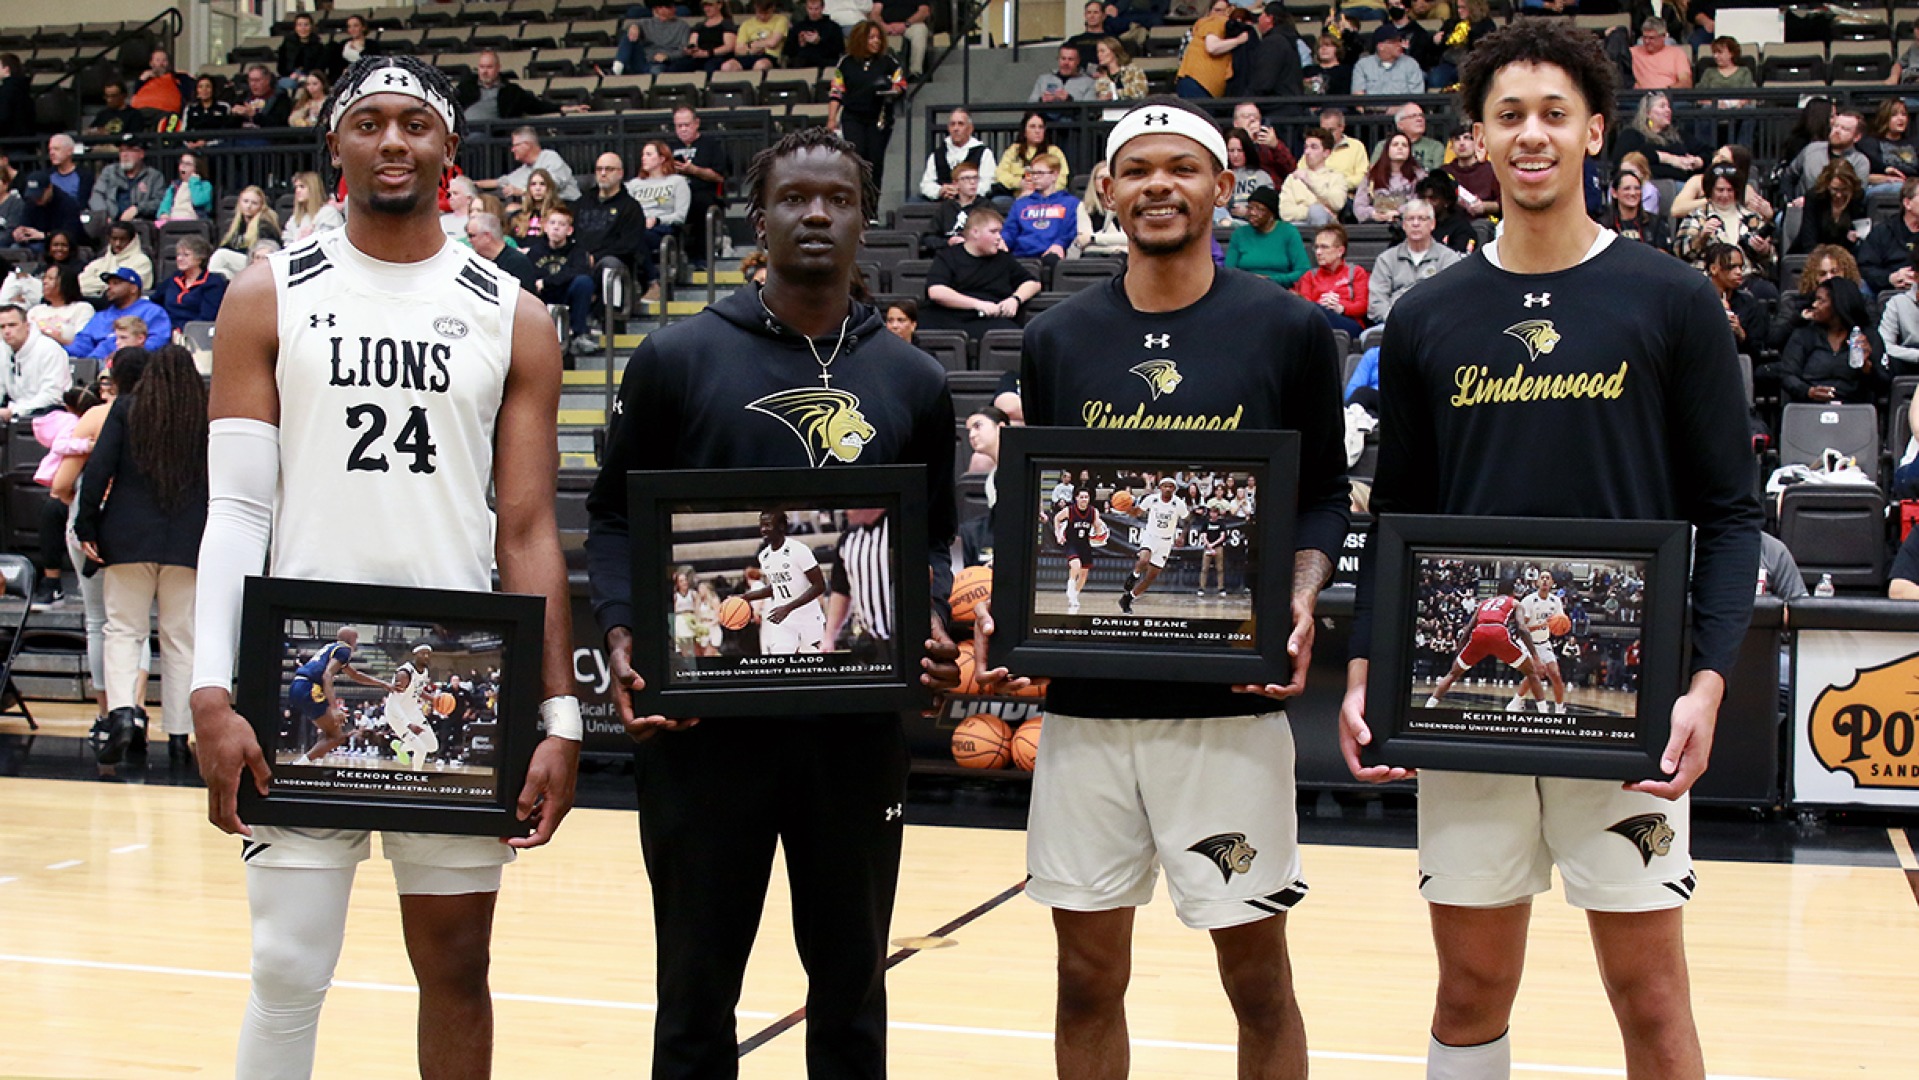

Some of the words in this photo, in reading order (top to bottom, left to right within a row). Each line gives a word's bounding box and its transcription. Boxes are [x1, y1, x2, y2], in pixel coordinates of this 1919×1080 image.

[329, 336, 451, 393] LIONS
[1451, 360, 1628, 407] Lindenwood
[1082, 400, 1244, 431] Lindenwood
[346, 403, 437, 474] 24
[1092, 617, 1140, 627] DARIUS
[1144, 619, 1188, 628] BEANE
[1033, 627, 1089, 636] LINDENWOOD
[1090, 629, 1140, 637] UNIVERSITY
[1141, 630, 1195, 639] BASKETBALL
[1227, 633, 1251, 641] 2024
[739, 657, 785, 666] AMORO
[789, 656, 824, 664] LADO
[676, 669, 733, 678] LINDENWOOD
[734, 668, 783, 676] UNIVERSITY
[784, 666, 837, 675] BASKETBALL
[869, 664, 892, 672] 2024
[1462, 711, 1503, 722] KEITH
[1506, 713, 1563, 724] HAYMON
[1567, 716, 1577, 725] II
[1409, 720, 1467, 731] LINDENWOOD
[1468, 724, 1519, 733] UNIVERSITY
[1520, 726, 1577, 736] BASKETBALL
[1611, 730, 1636, 739] 2024
[336, 769, 390, 781] KEENON
[394, 772, 429, 783] COLE
[274, 778, 332, 788] LINDENWOOD
[333, 781, 383, 790] UNIVERSITY
[384, 783, 438, 793] BASKETBALL
